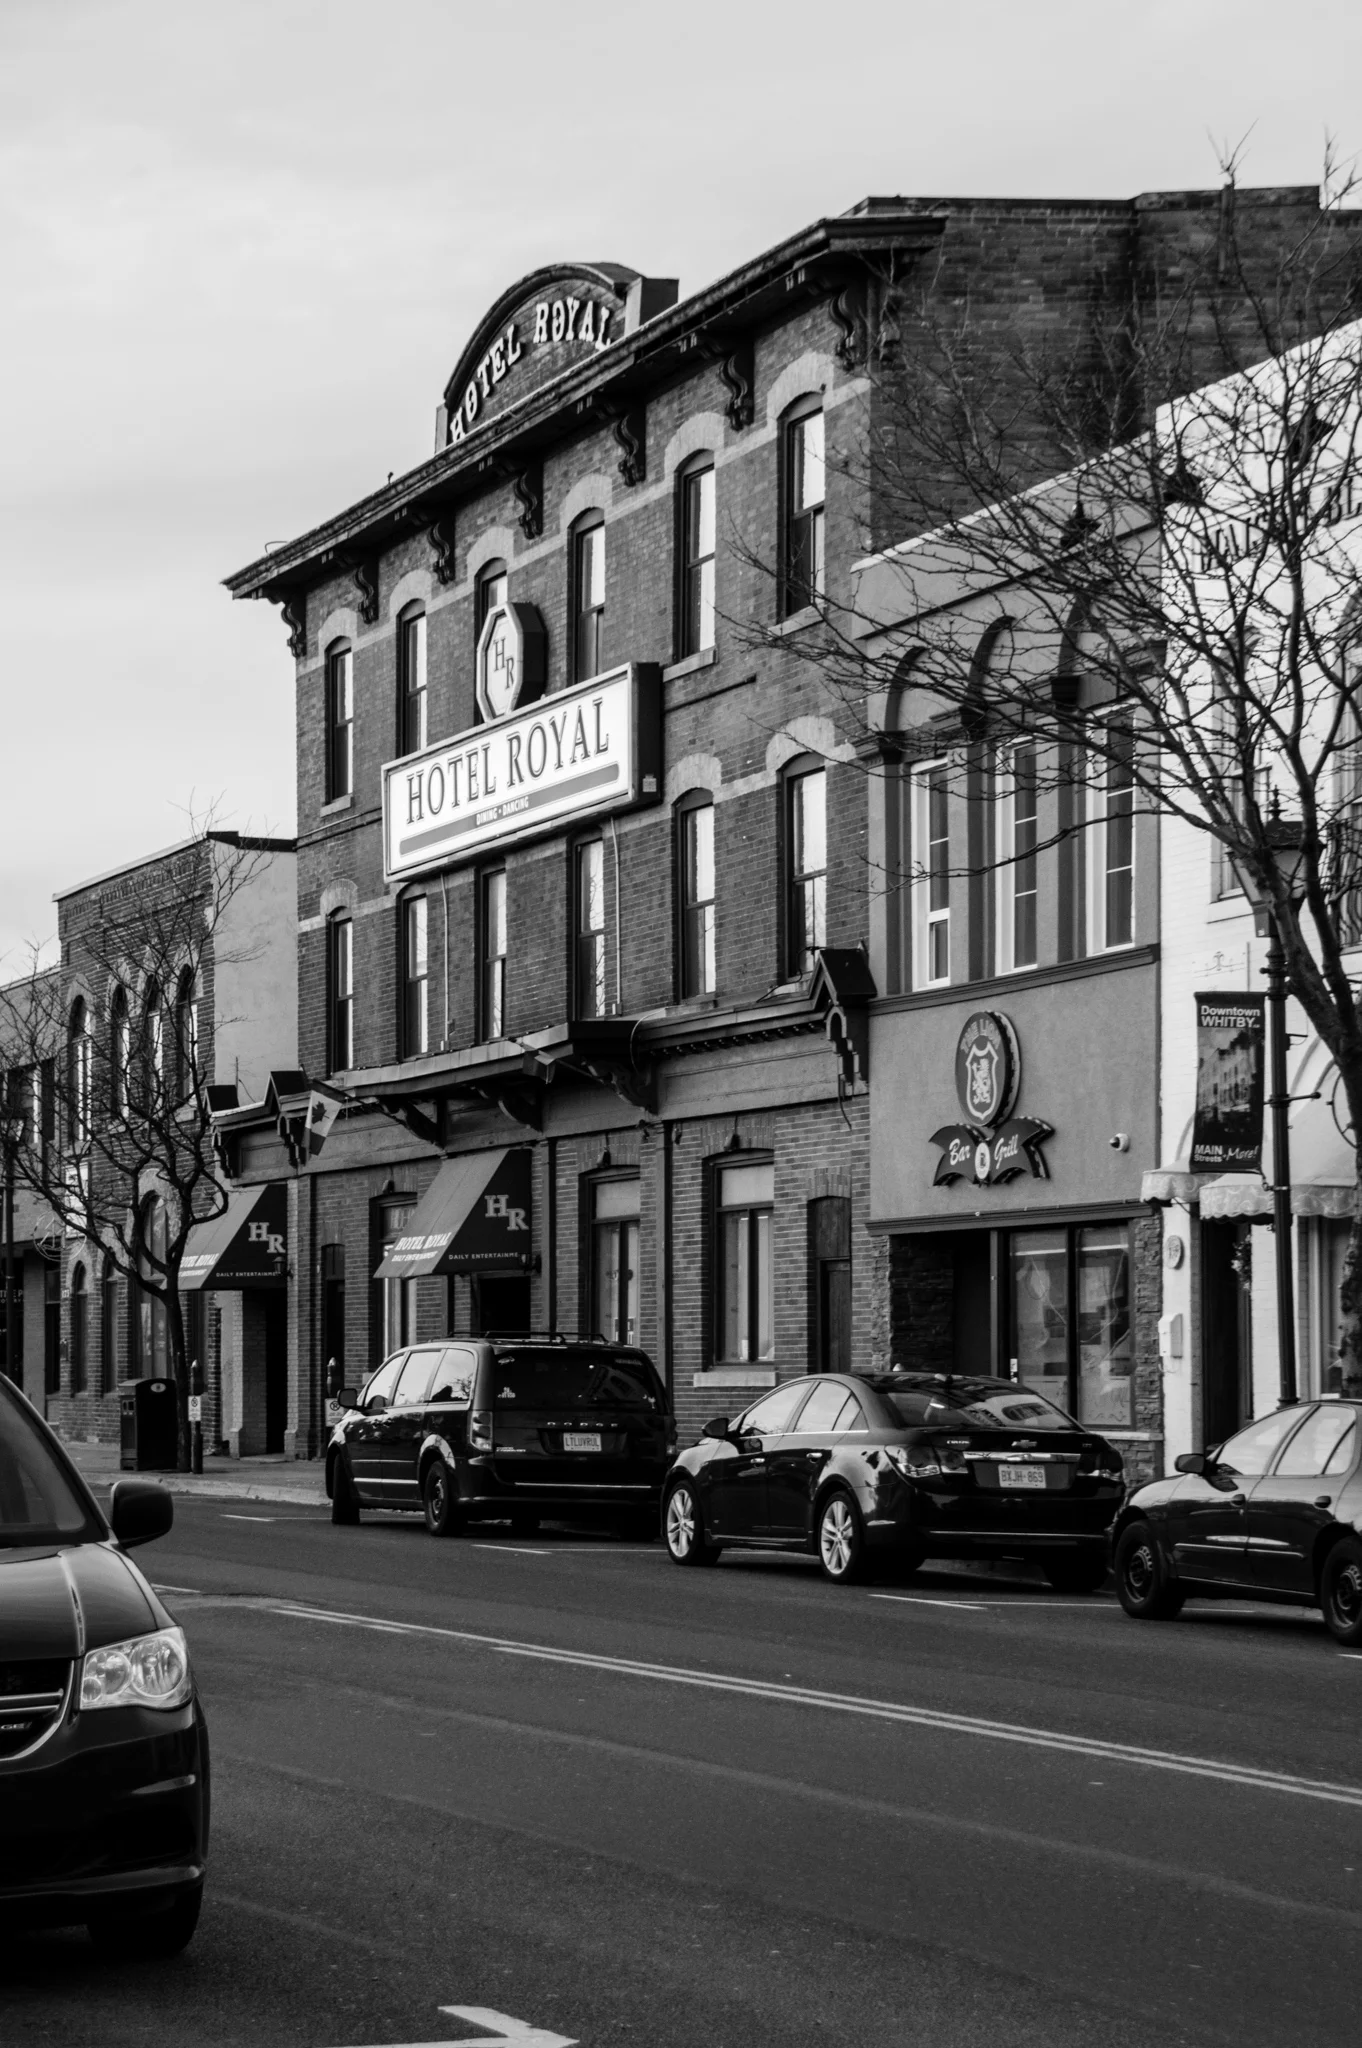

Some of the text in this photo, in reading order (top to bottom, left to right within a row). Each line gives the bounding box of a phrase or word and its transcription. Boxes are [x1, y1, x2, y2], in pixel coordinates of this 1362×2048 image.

[450, 296, 612, 442] HOTEL ROYAL
[406, 697, 610, 825] HOTEL ROYAL
[476, 797, 529, 826] DINING DANCING
[1201, 1005, 1260, 1016] Downtown
[1201, 1015, 1256, 1028] WHITBY
[949, 1138, 971, 1166] Bar
[994, 1133, 1019, 1170] Grill
[1194, 1144, 1223, 1155] MAIN
[1193, 1154, 1222, 1163] Streets
[394, 1231, 452, 1251] HOTEL ROYAL
[179, 1255, 199, 1268] OTEL
[471, 1252, 519, 1260] ENTERTAINME
